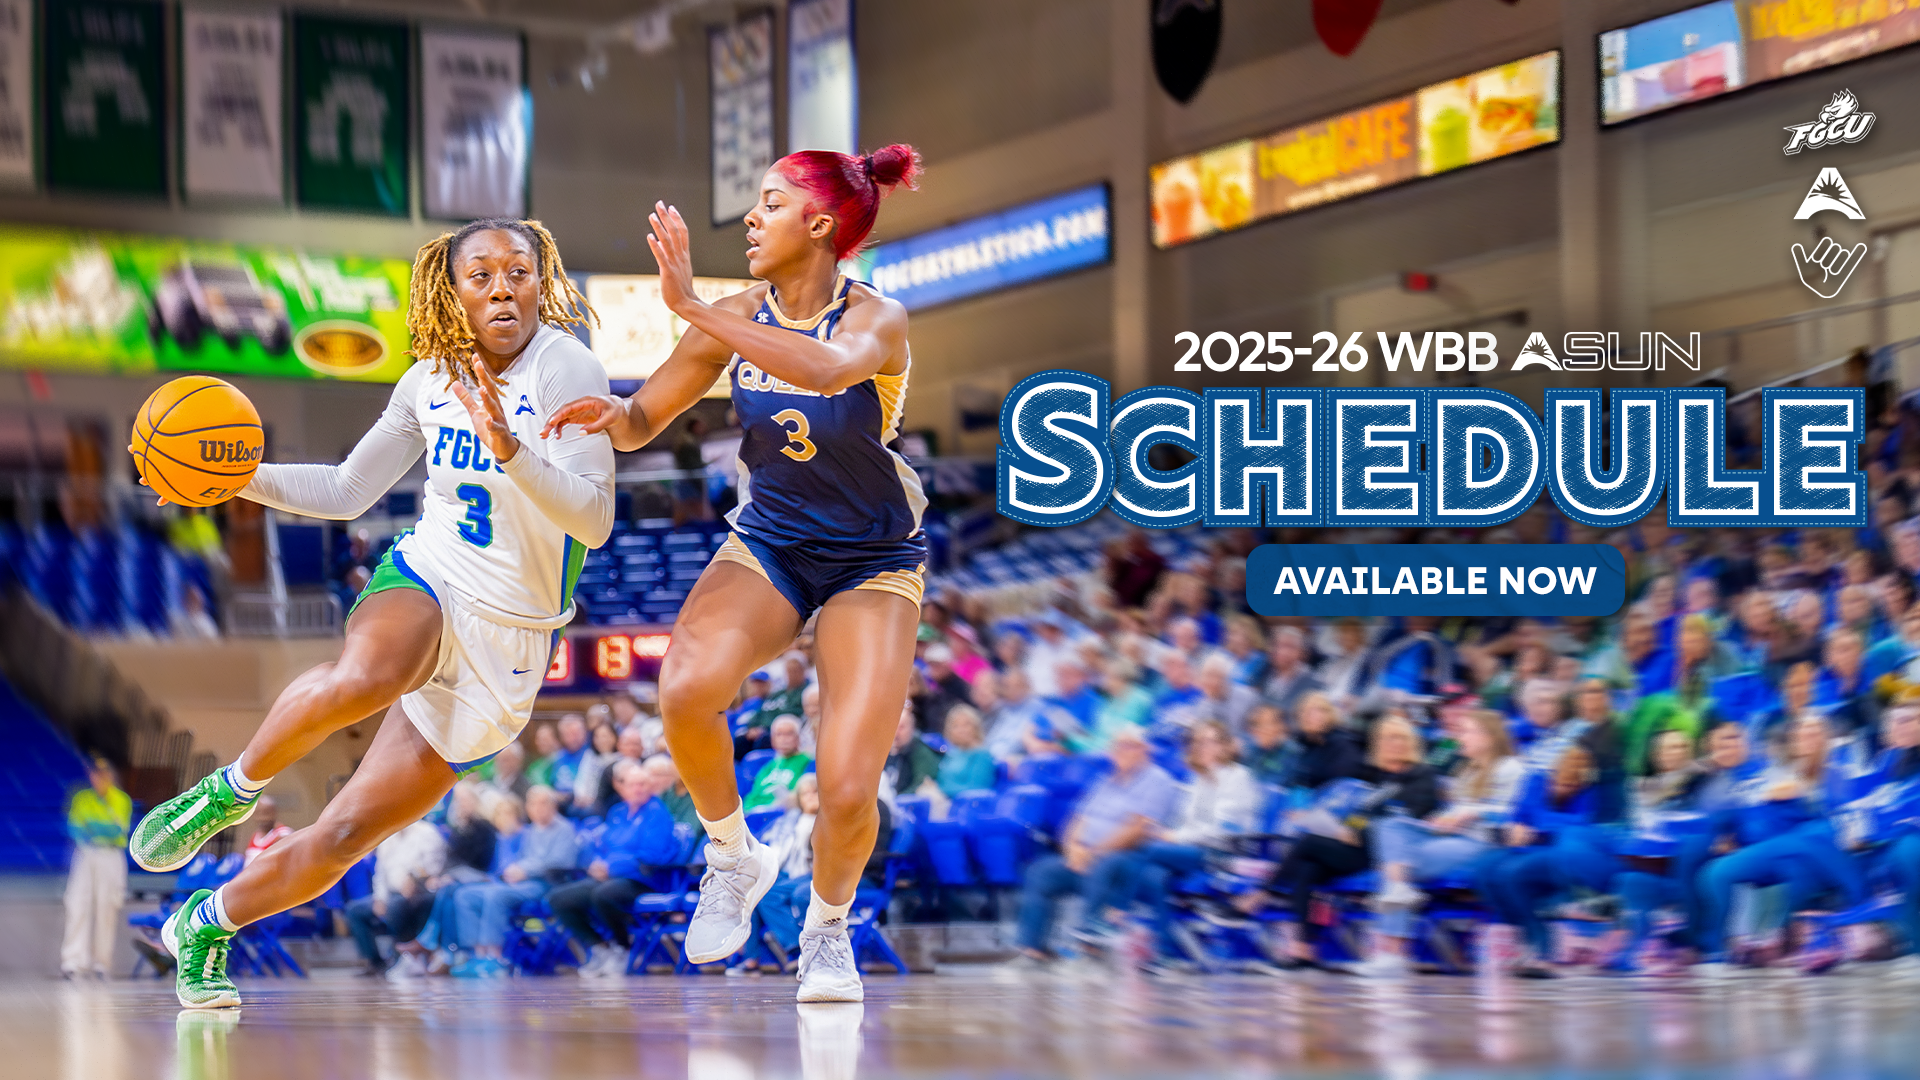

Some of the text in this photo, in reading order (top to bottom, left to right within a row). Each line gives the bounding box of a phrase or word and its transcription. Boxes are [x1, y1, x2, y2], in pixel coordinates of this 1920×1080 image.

[432, 426, 518, 474] FGC
[771, 408, 818, 462] 3
[455, 482, 494, 548] 3
